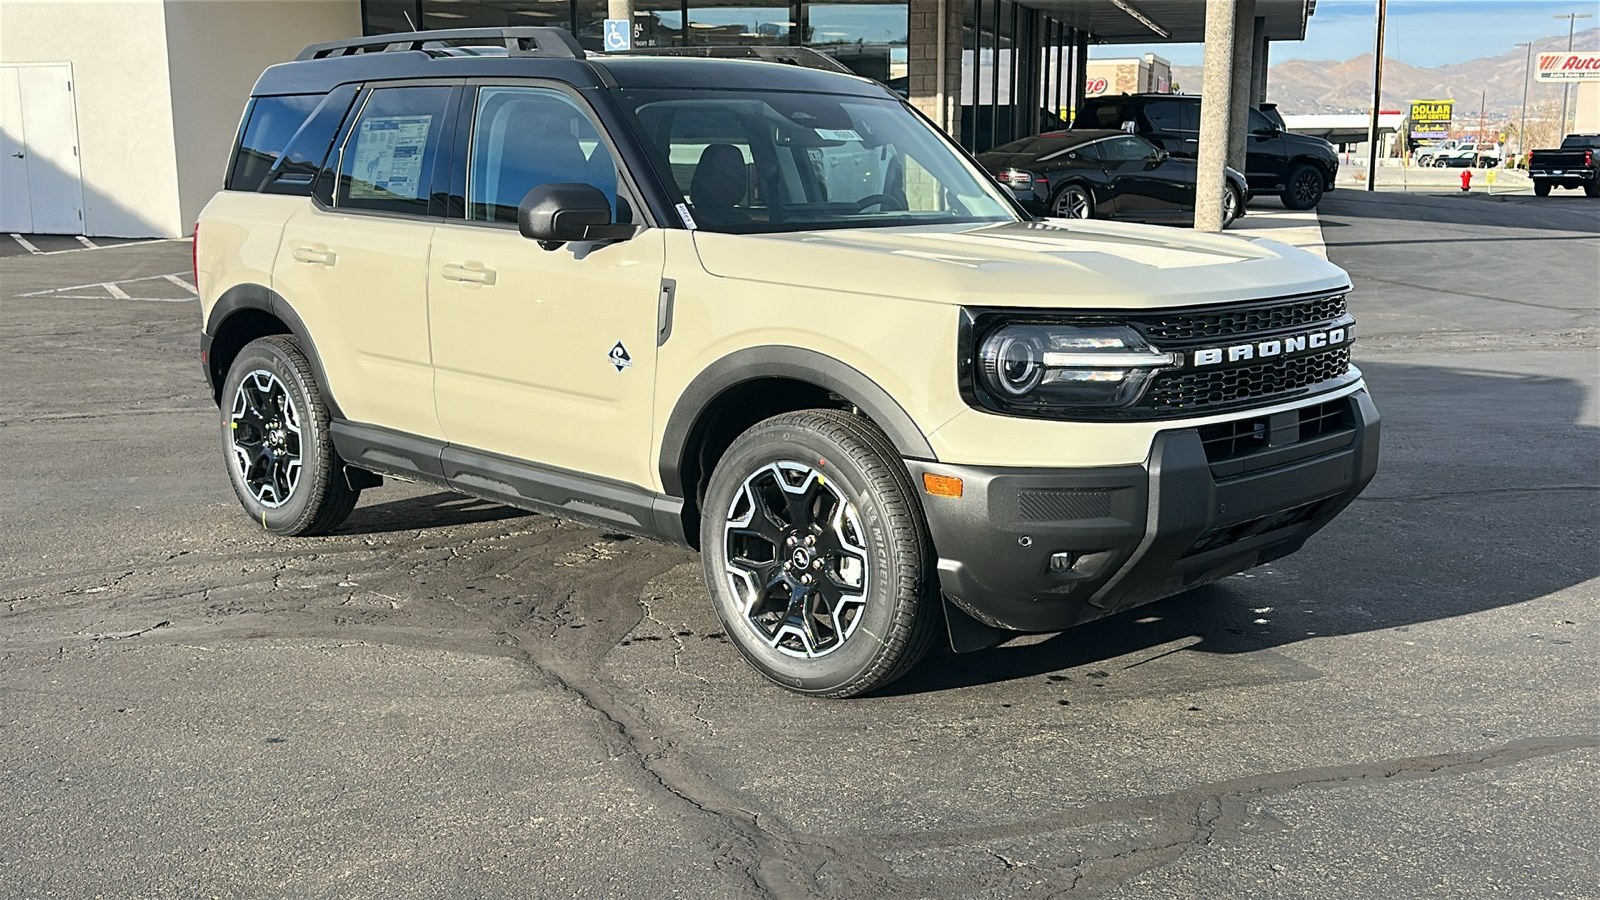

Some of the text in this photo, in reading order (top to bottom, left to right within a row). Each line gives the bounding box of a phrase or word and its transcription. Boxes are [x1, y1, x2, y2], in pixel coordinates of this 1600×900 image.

[1561, 55, 1600, 70] Auto
[1086, 79, 1105, 92] ne
[1412, 105, 1451, 114] DOLLAR
[1194, 328, 1345, 367] BRONCO
[873, 527, 888, 606] MICHELIN
